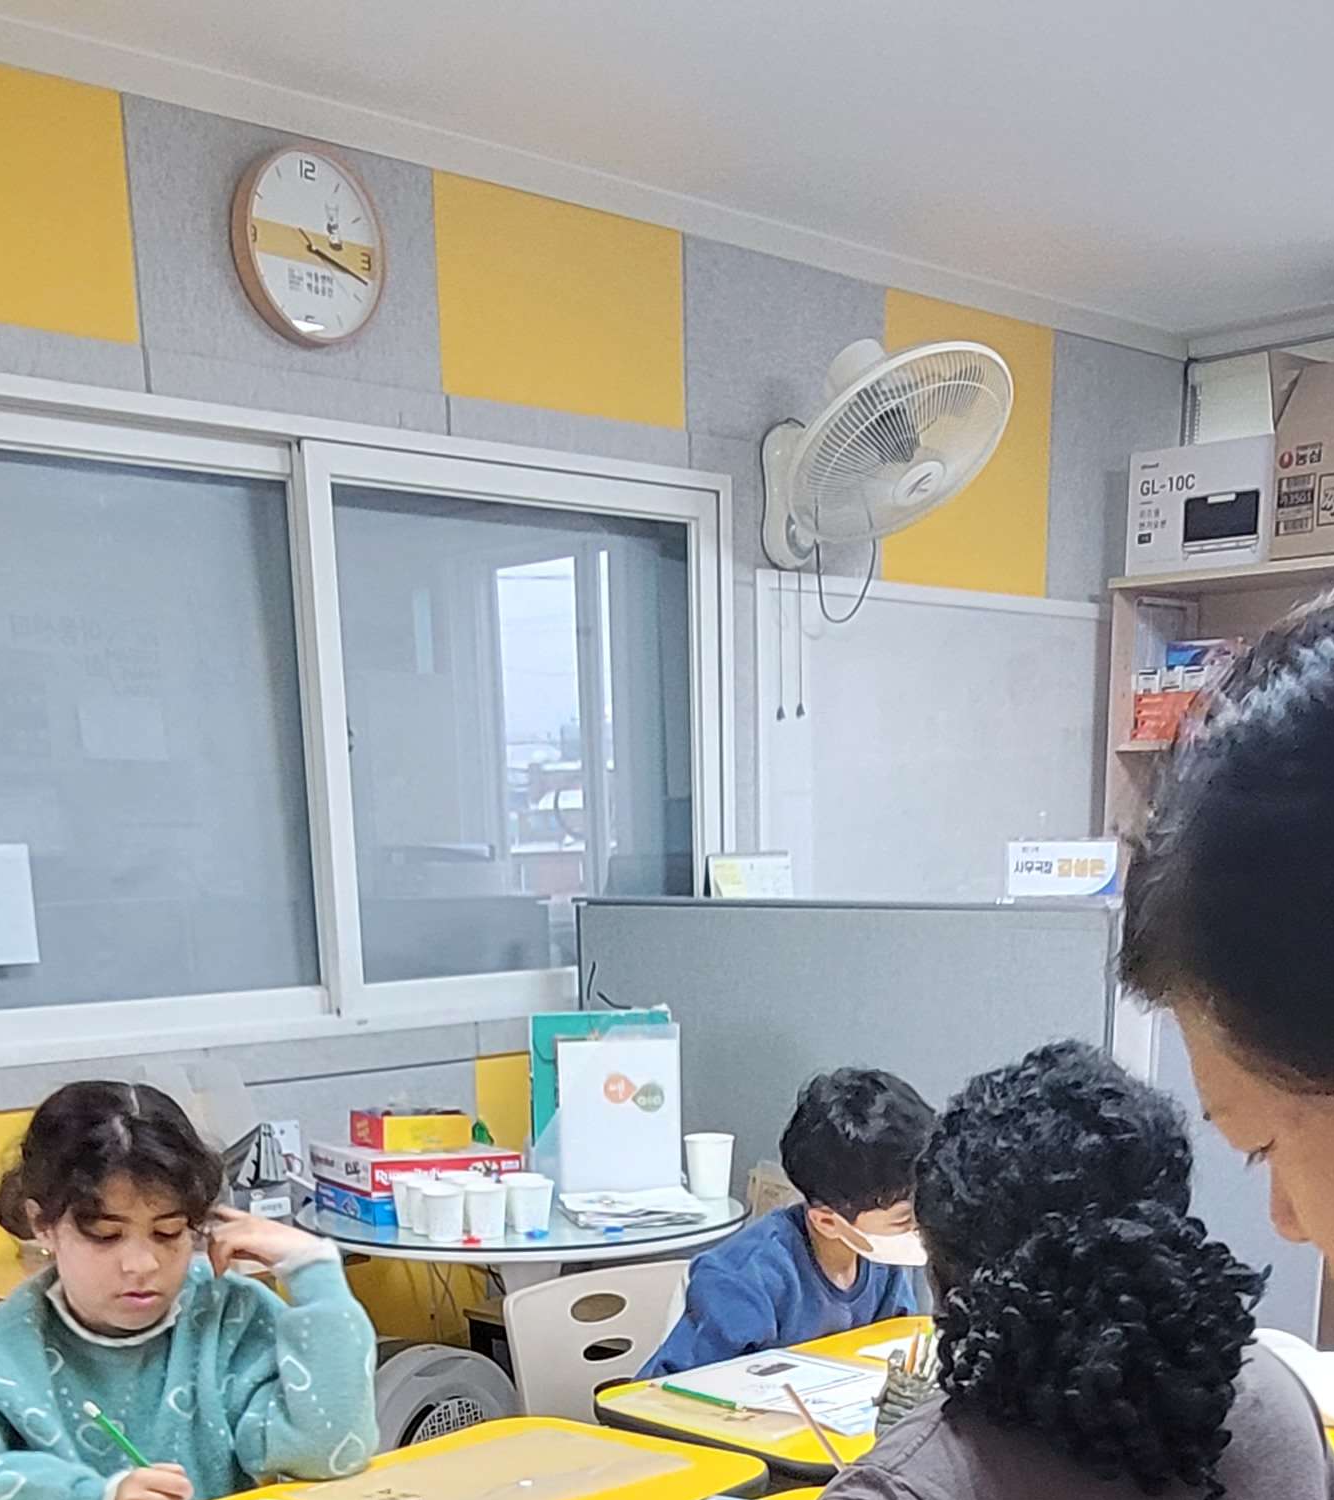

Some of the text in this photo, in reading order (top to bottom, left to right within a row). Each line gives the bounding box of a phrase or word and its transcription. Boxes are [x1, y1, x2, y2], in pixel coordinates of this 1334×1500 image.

[299, 159, 316, 181] 12
[361, 252, 372, 271] 3
[1140, 473, 1196, 496] GL-10C
